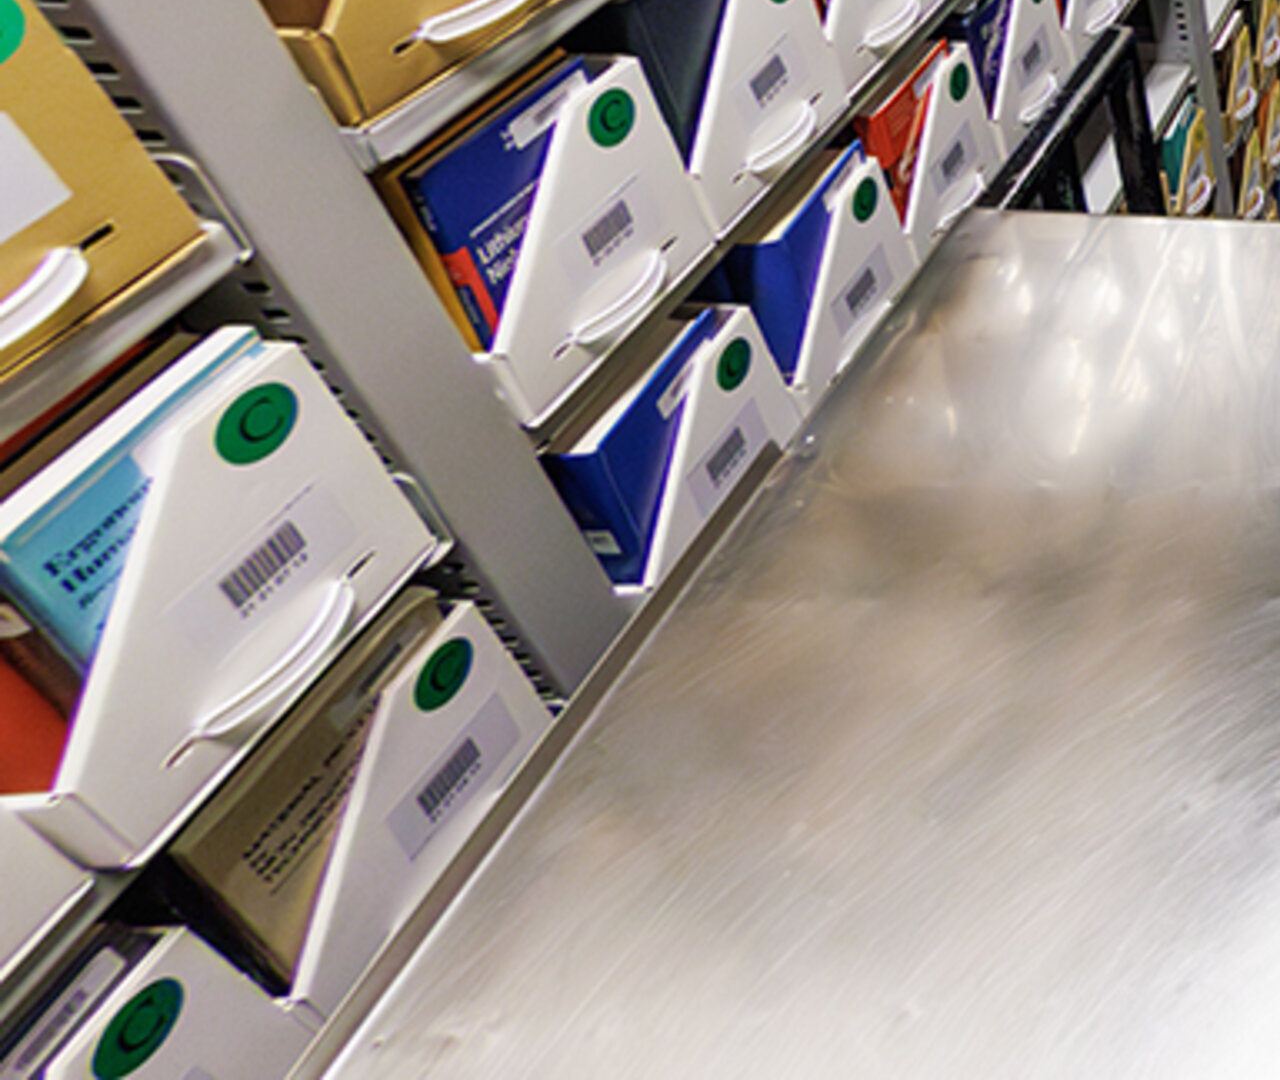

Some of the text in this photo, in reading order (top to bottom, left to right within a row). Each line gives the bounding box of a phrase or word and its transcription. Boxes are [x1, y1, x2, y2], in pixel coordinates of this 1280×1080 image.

[600, 98, 626, 133] C
[238, 396, 283, 445] C
[429, 650, 464, 693] C
[117, 994, 165, 1053] C
